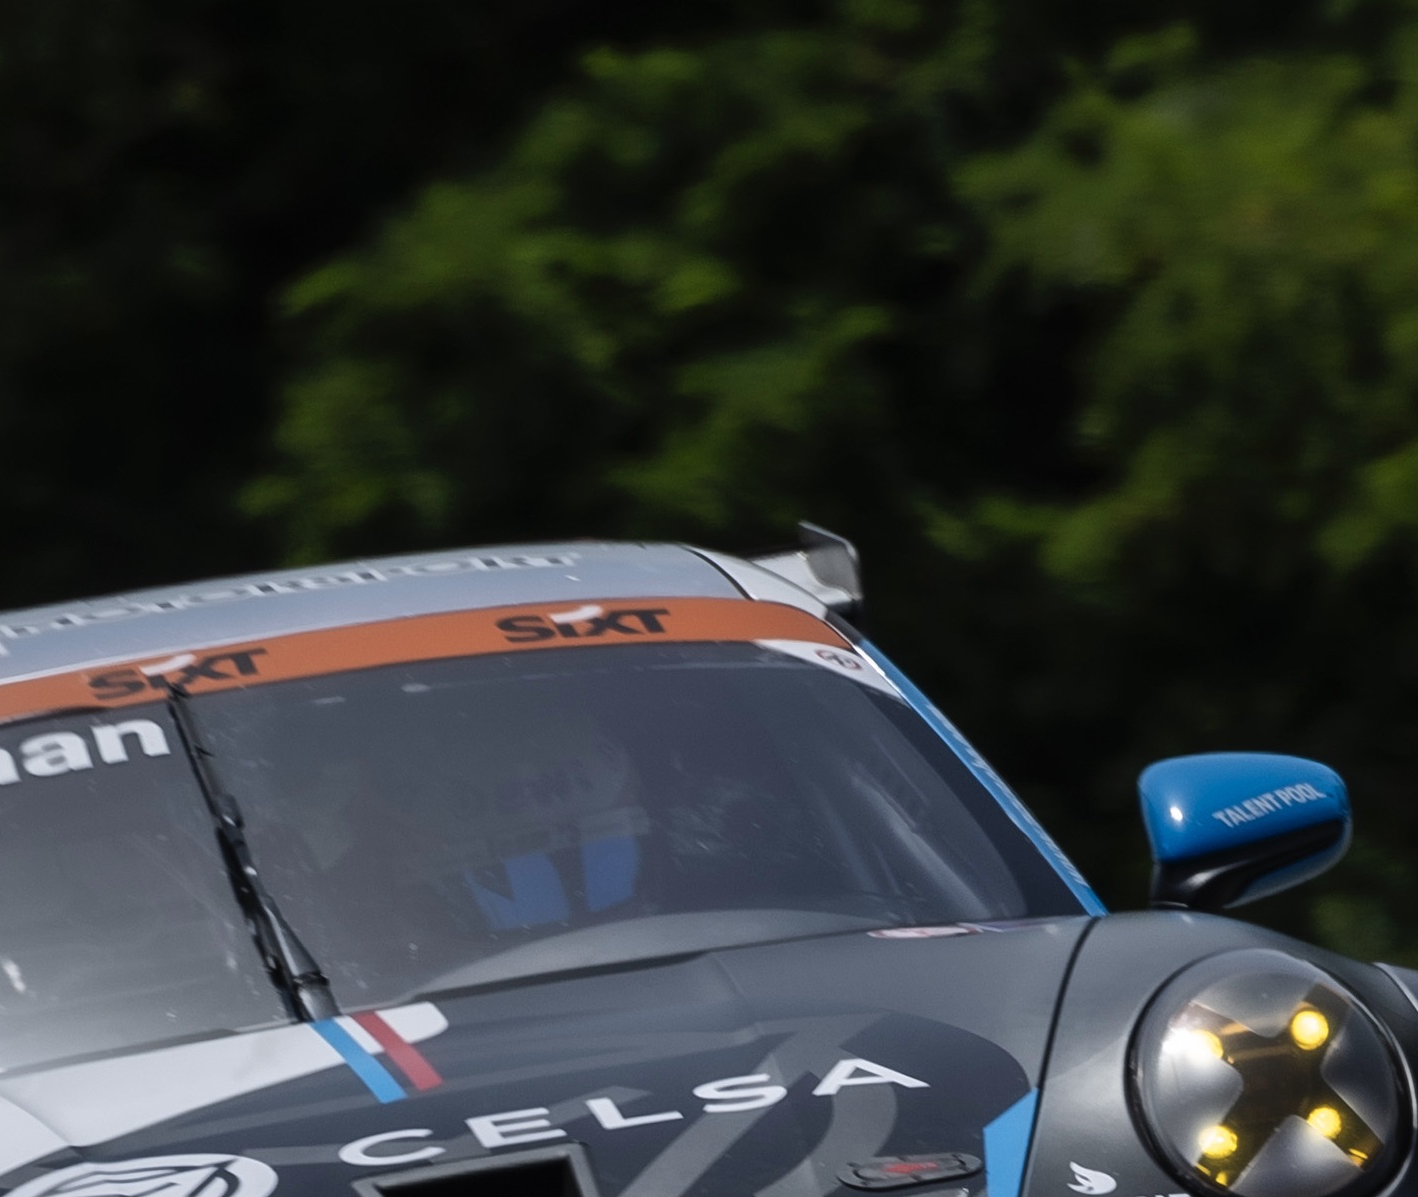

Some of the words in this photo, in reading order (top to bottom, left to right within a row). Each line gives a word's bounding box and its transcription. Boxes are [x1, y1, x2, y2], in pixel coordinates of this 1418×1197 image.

[1212, 792, 1283, 828] TALENT
[1273, 783, 1328, 807] POOL
[338, 1058, 931, 1166] CELSA
